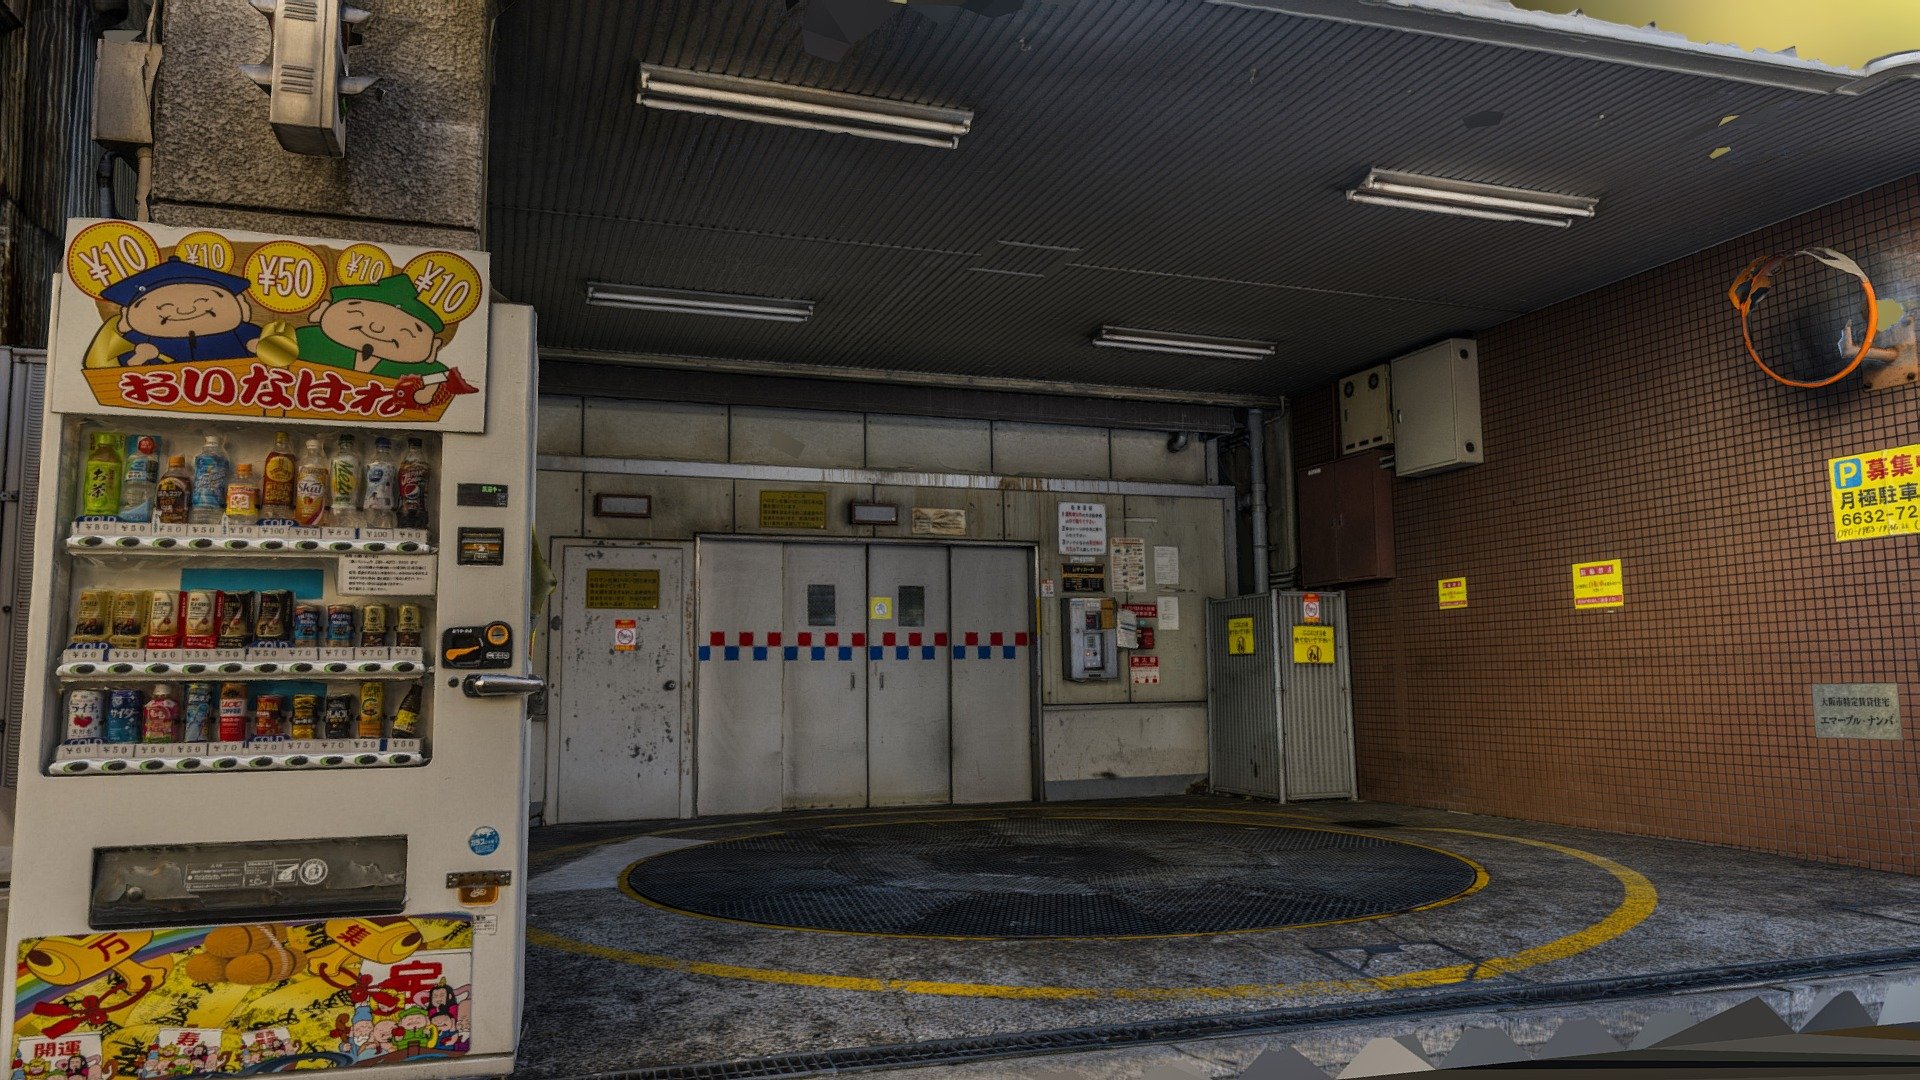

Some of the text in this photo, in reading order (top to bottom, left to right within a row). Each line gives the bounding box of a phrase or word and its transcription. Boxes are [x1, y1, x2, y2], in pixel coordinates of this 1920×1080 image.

[78, 234, 147, 287] ¥10
[185, 243, 225, 270] ¥10
[346, 250, 385, 285] ¥10
[258, 254, 314, 298] ¥50
[415, 260, 470, 314] ¥10
[1865, 454, 1920, 481] 募集
[1840, 482, 1920, 510] 月極駐車
